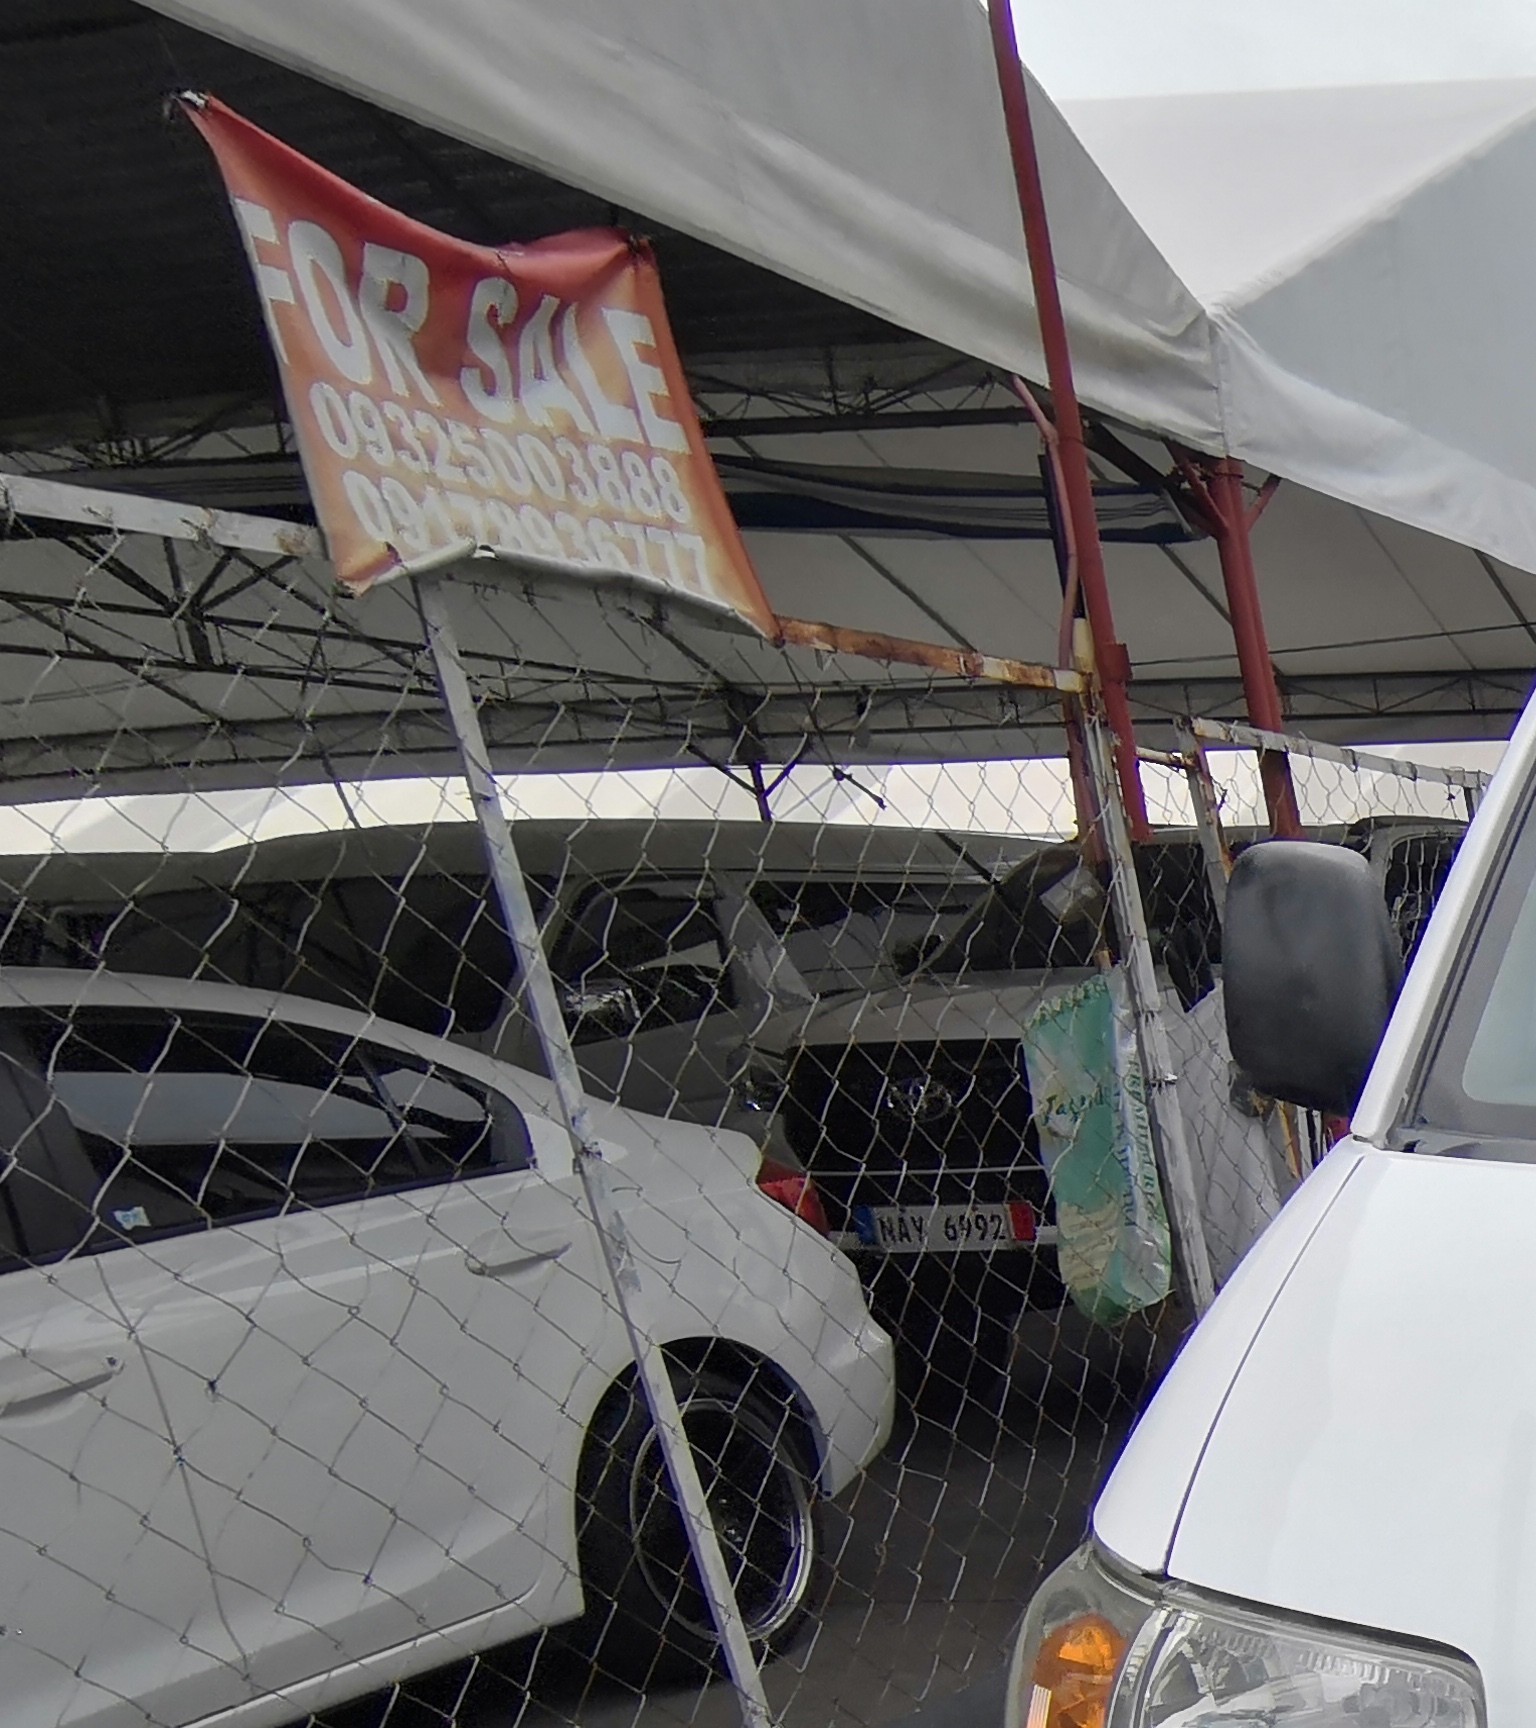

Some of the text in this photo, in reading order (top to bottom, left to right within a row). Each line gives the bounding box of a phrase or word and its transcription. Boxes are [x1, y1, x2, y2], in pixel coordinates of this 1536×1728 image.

[233, 198, 692, 456] FOR SALE
[309, 381, 692, 524] 09325003888
[878, 1215, 925, 1244] NAY
